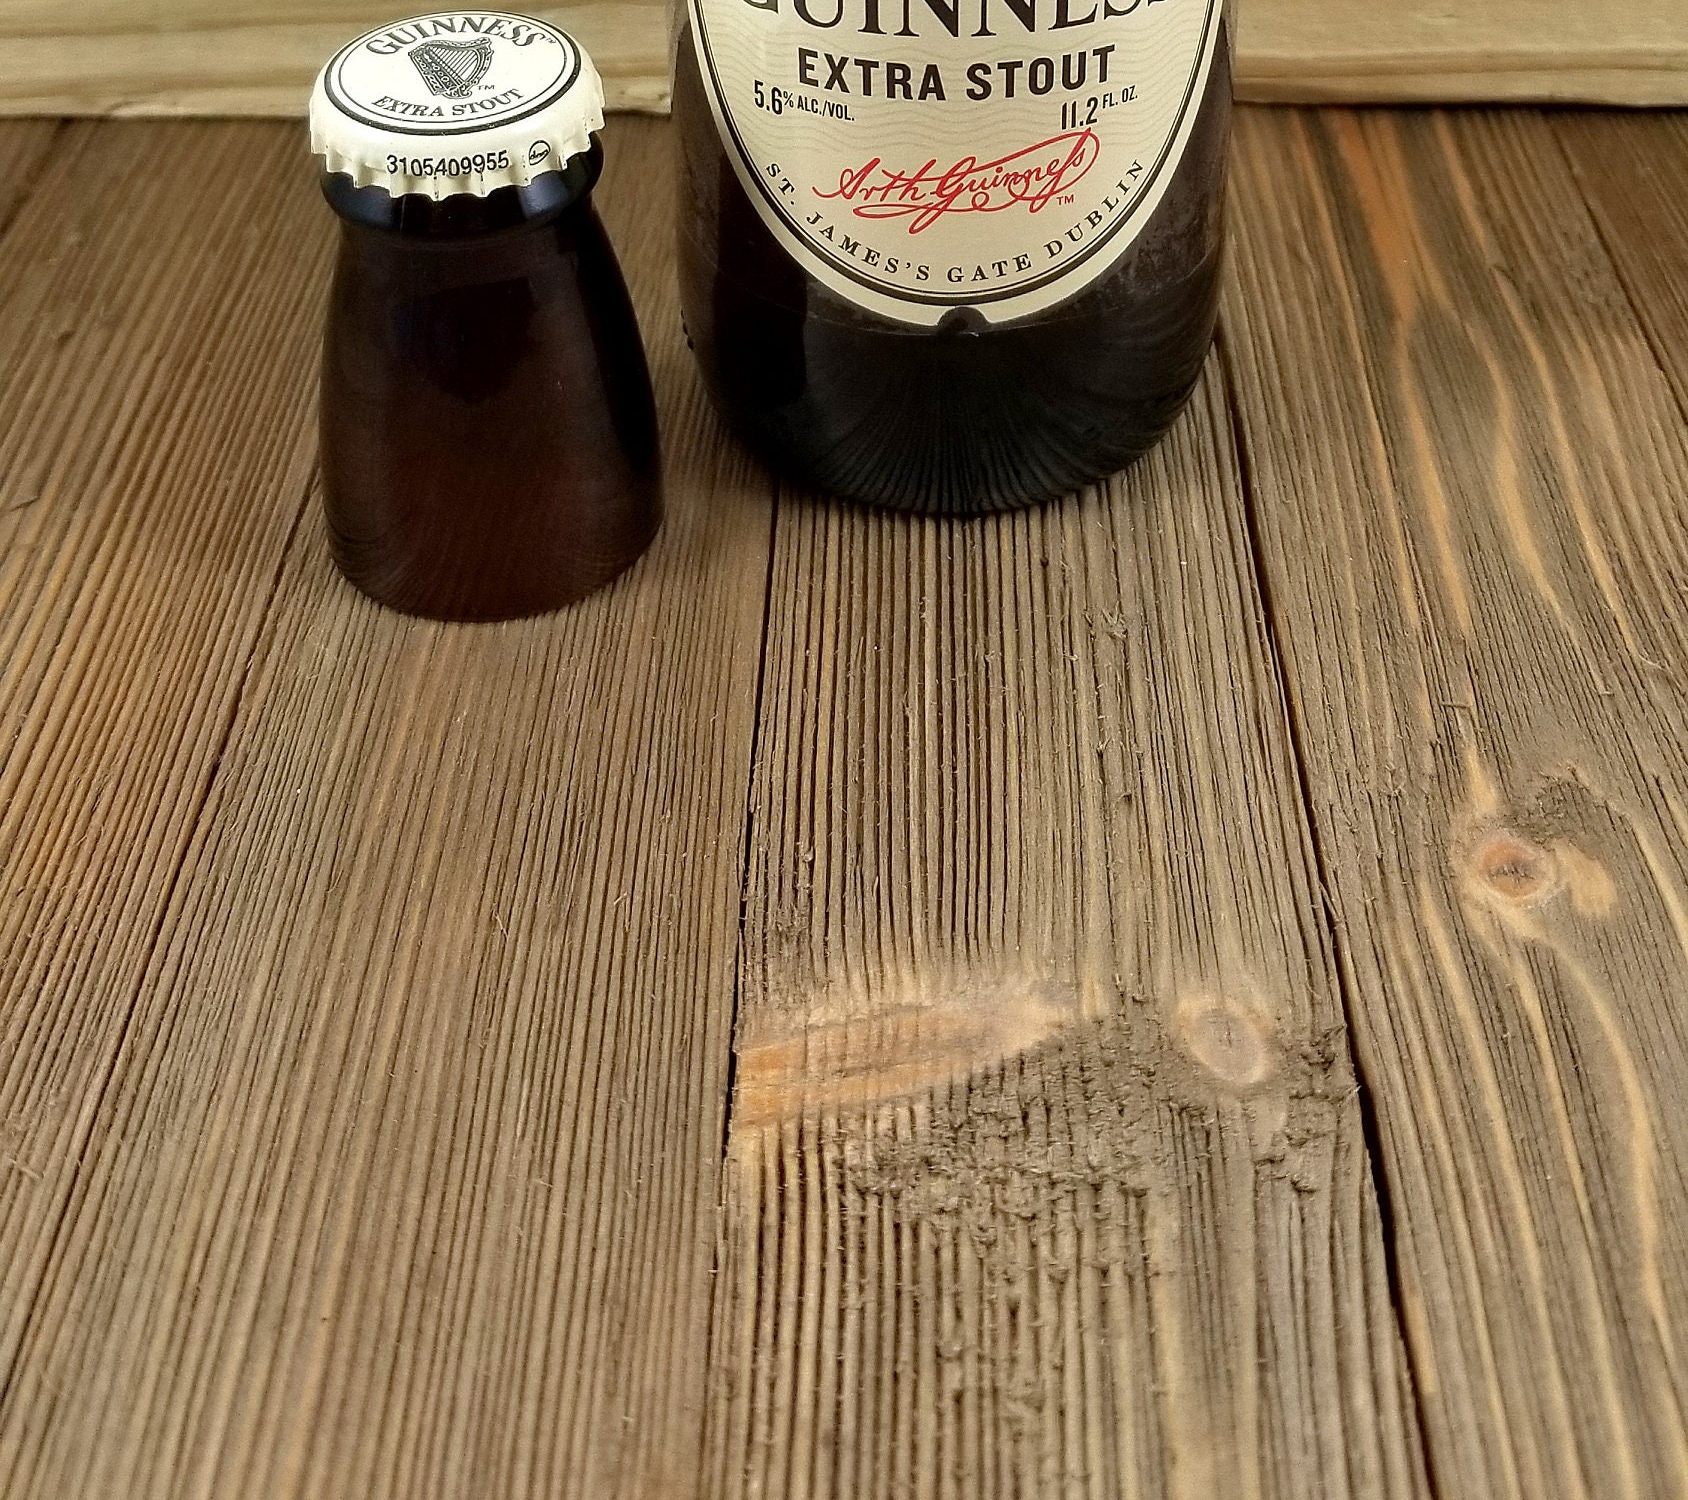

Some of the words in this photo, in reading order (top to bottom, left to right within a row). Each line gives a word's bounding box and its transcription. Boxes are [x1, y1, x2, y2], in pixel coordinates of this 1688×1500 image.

[366, 16, 545, 54] GUINNESS
[797, 46, 948, 102] EXTRA
[965, 43, 1117, 100] STOUT
[371, 95, 445, 117] EXTRA
[452, 88, 525, 117] STOUT
[753, 78, 795, 116] 5.6%
[796, 94, 855, 122] ALC./VOL.
[1060, 95, 1098, 131] 11.2
[1101, 91, 1119, 110] FL.
[1121, 83, 1139, 105] OZ.
[386, 150, 510, 177] 3105409955
[764, 161, 797, 207] ST.
[947, 254, 1033, 284] GATE
[1046, 159, 1145, 259] DUBLIN
